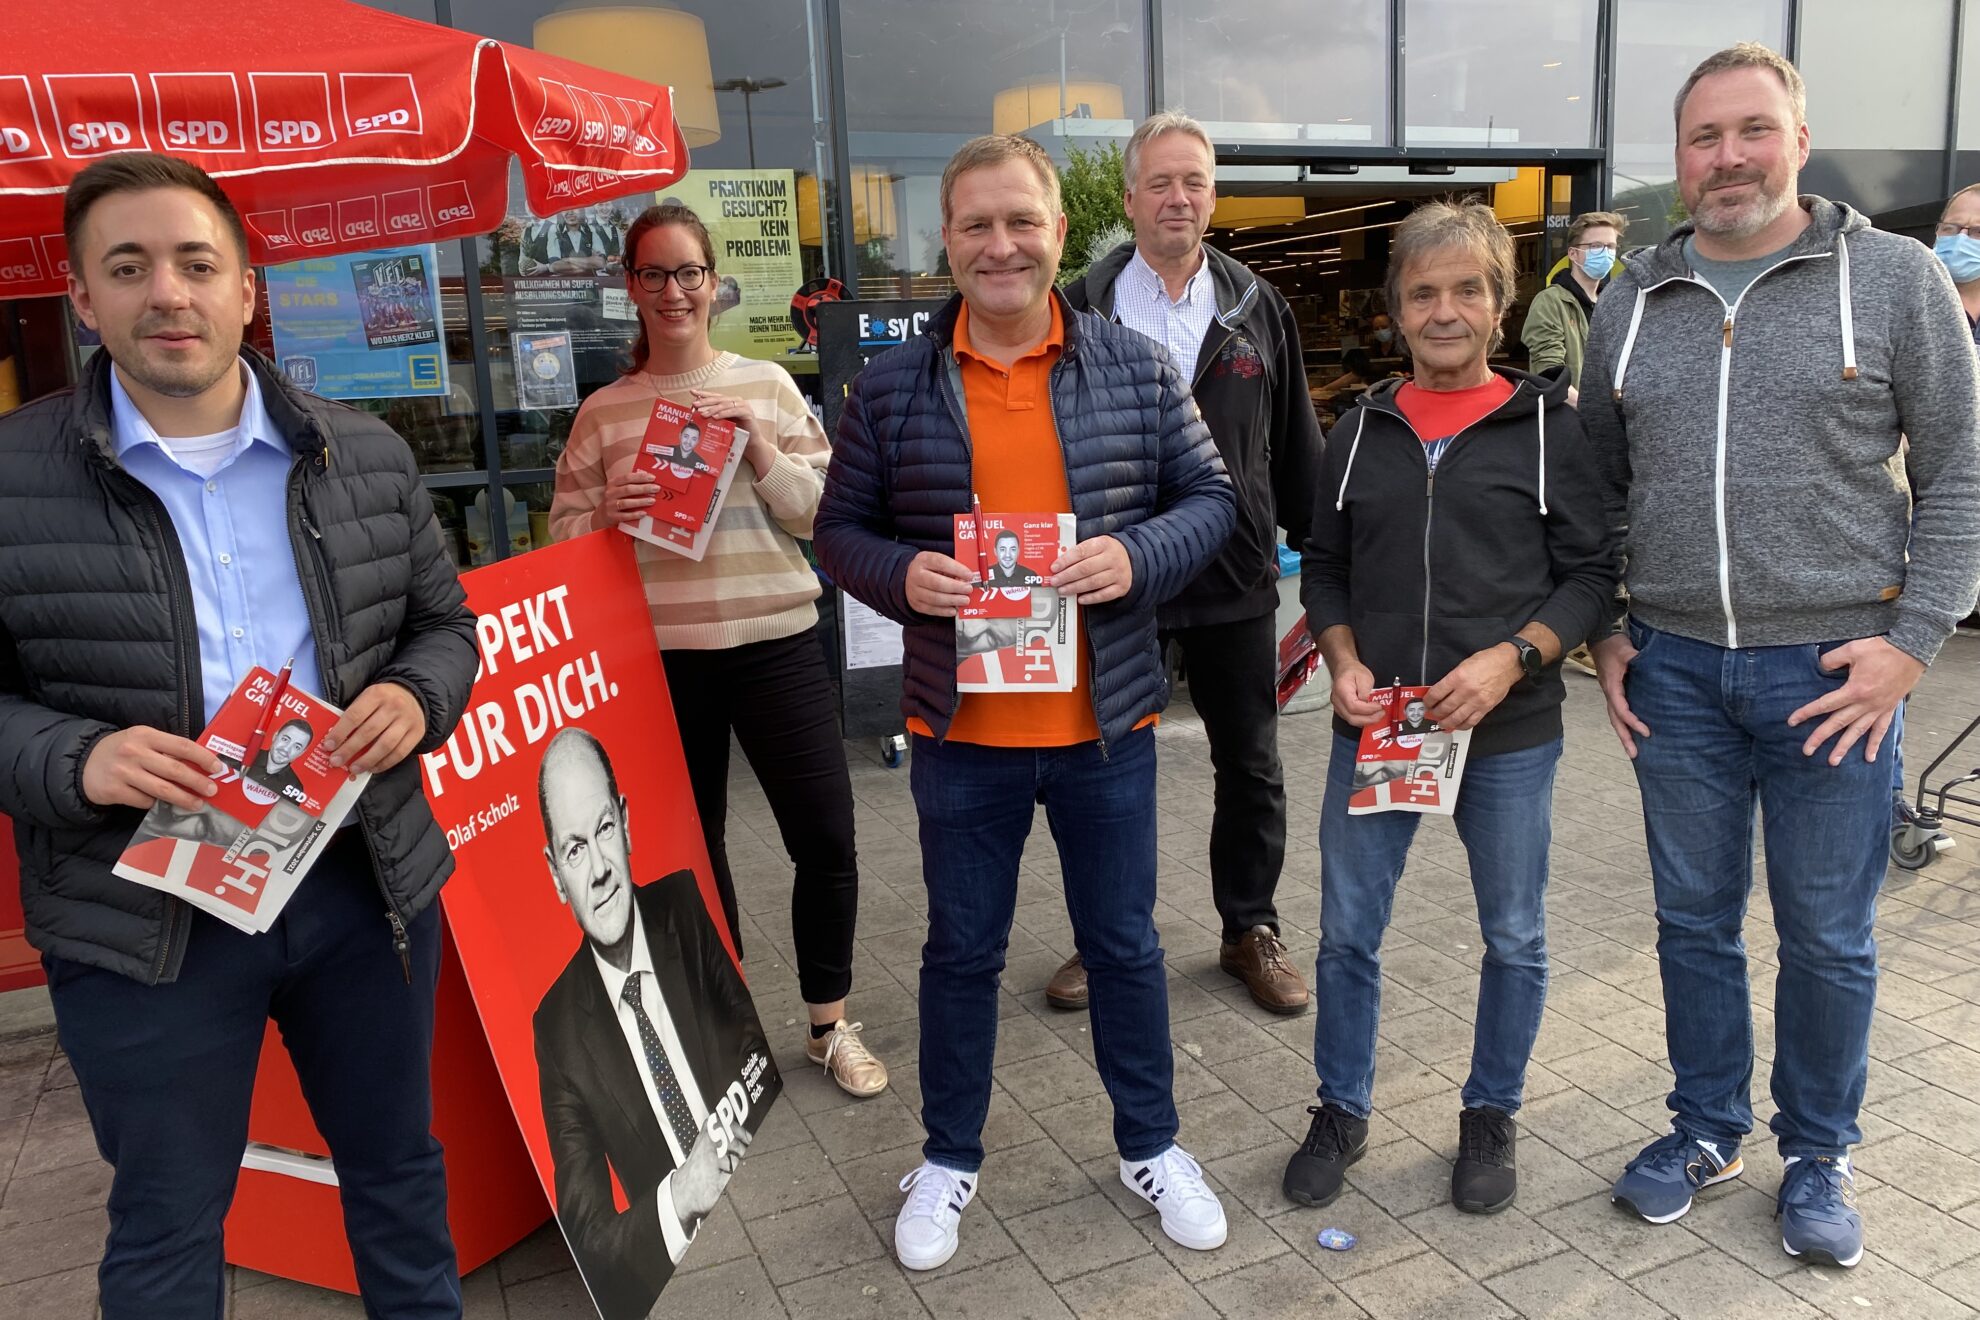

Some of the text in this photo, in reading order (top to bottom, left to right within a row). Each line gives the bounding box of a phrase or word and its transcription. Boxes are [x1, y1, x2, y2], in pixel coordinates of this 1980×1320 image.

[67, 108, 410, 150] SPD SPD SPD SPD
[537, 117, 656, 151] SPD SPD SPD SPD
[708, 180, 787, 198] PRAKTIKUM
[722, 200, 787, 218] GESUCHT?
[760, 220, 789, 237] KEIN
[726, 240, 791, 257] PROBLEM!
[513, 280, 560, 289] WILLKOMMEN
[561, 280, 570, 288] IM
[571, 279, 594, 288] SUPER
[515, 290, 587, 300] AUSBILDUNGSMARKT!
[749, 316, 766, 324] MACH
[767, 315, 784, 324] MEHR
[383, 335, 397, 343] DAS
[415, 330, 435, 339] KLEBT
[656, 411, 679, 425] GAVA
[694, 462, 710, 472] SPD
[674, 511, 688, 520] SPD
[958, 519, 1005, 530] MAUEL
[1040, 521, 1054, 529] klar
[1024, 575, 1043, 584] SPD
[963, 608, 978, 616] SPD
[474, 584, 574, 680] PEKT
[245, 688, 282, 717] GAA
[513, 650, 619, 745] DICH.
[1410, 742, 1445, 802] DICH.
[282, 785, 308, 803] SPD
[446, 793, 520, 851] Olaf Scholz
[214, 805, 308, 896] DICH.
[286, 832, 318, 872] September 2021
[707, 1081, 749, 1159] SPD
